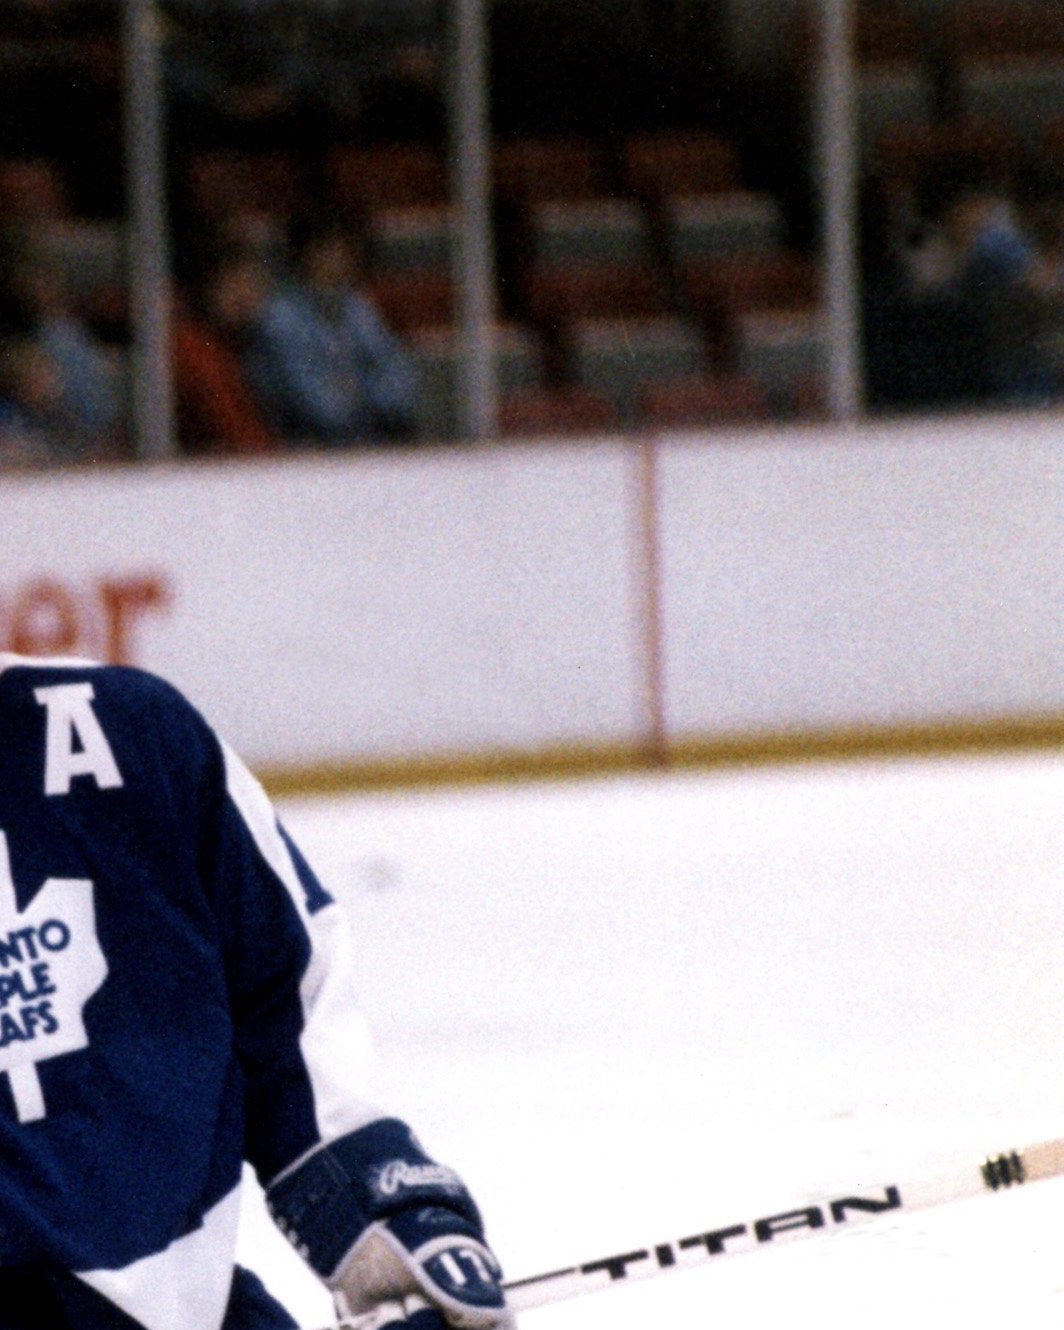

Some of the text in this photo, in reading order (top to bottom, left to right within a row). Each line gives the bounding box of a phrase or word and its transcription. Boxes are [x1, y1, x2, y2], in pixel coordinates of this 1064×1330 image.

[35, 682, 124, 797] A
[439, 1248, 493, 1286] 17
[580, 1185, 902, 1281] TITAN
